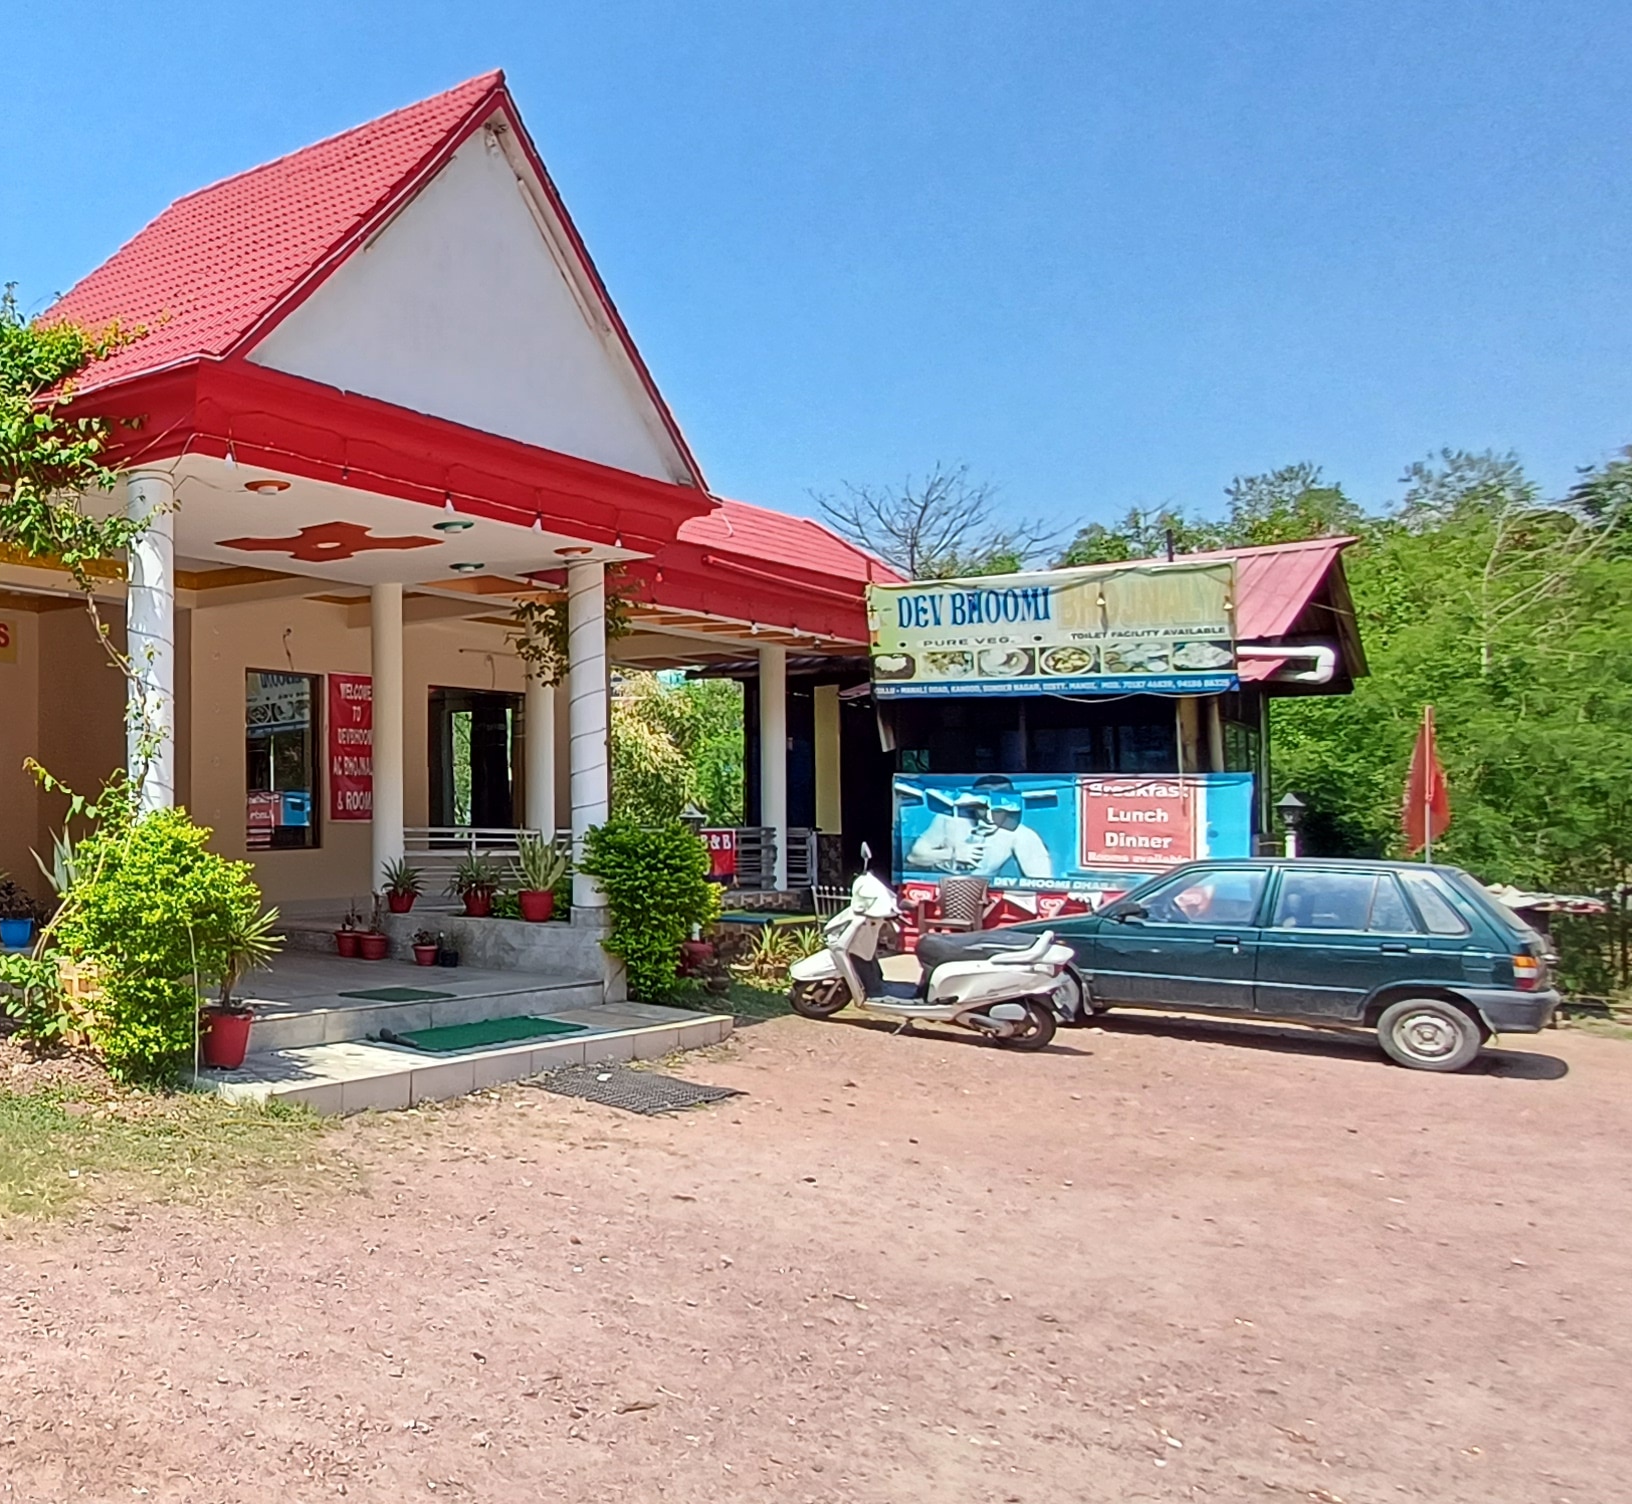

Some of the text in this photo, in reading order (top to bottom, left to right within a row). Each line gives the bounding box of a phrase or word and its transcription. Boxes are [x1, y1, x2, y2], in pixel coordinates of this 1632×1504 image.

[897, 593, 943, 628] DEV
[950, 586, 1051, 627] BHOOMI
[1071, 626, 1226, 640] TOILET FACILITY AVAILABLE
[923, 636, 1016, 647] PURE VEG.
[352, 705, 362, 722] TO
[333, 756, 343, 775] AC
[337, 790, 344, 810] &
[1107, 807, 1169, 822] Lunch
[710, 834, 720, 849] &
[722, 834, 731, 849] B
[1105, 832, 1173, 848] Dinner
[993, 877, 1017, 887] DEV
[1019, 878, 1070, 889] BHOOMI
